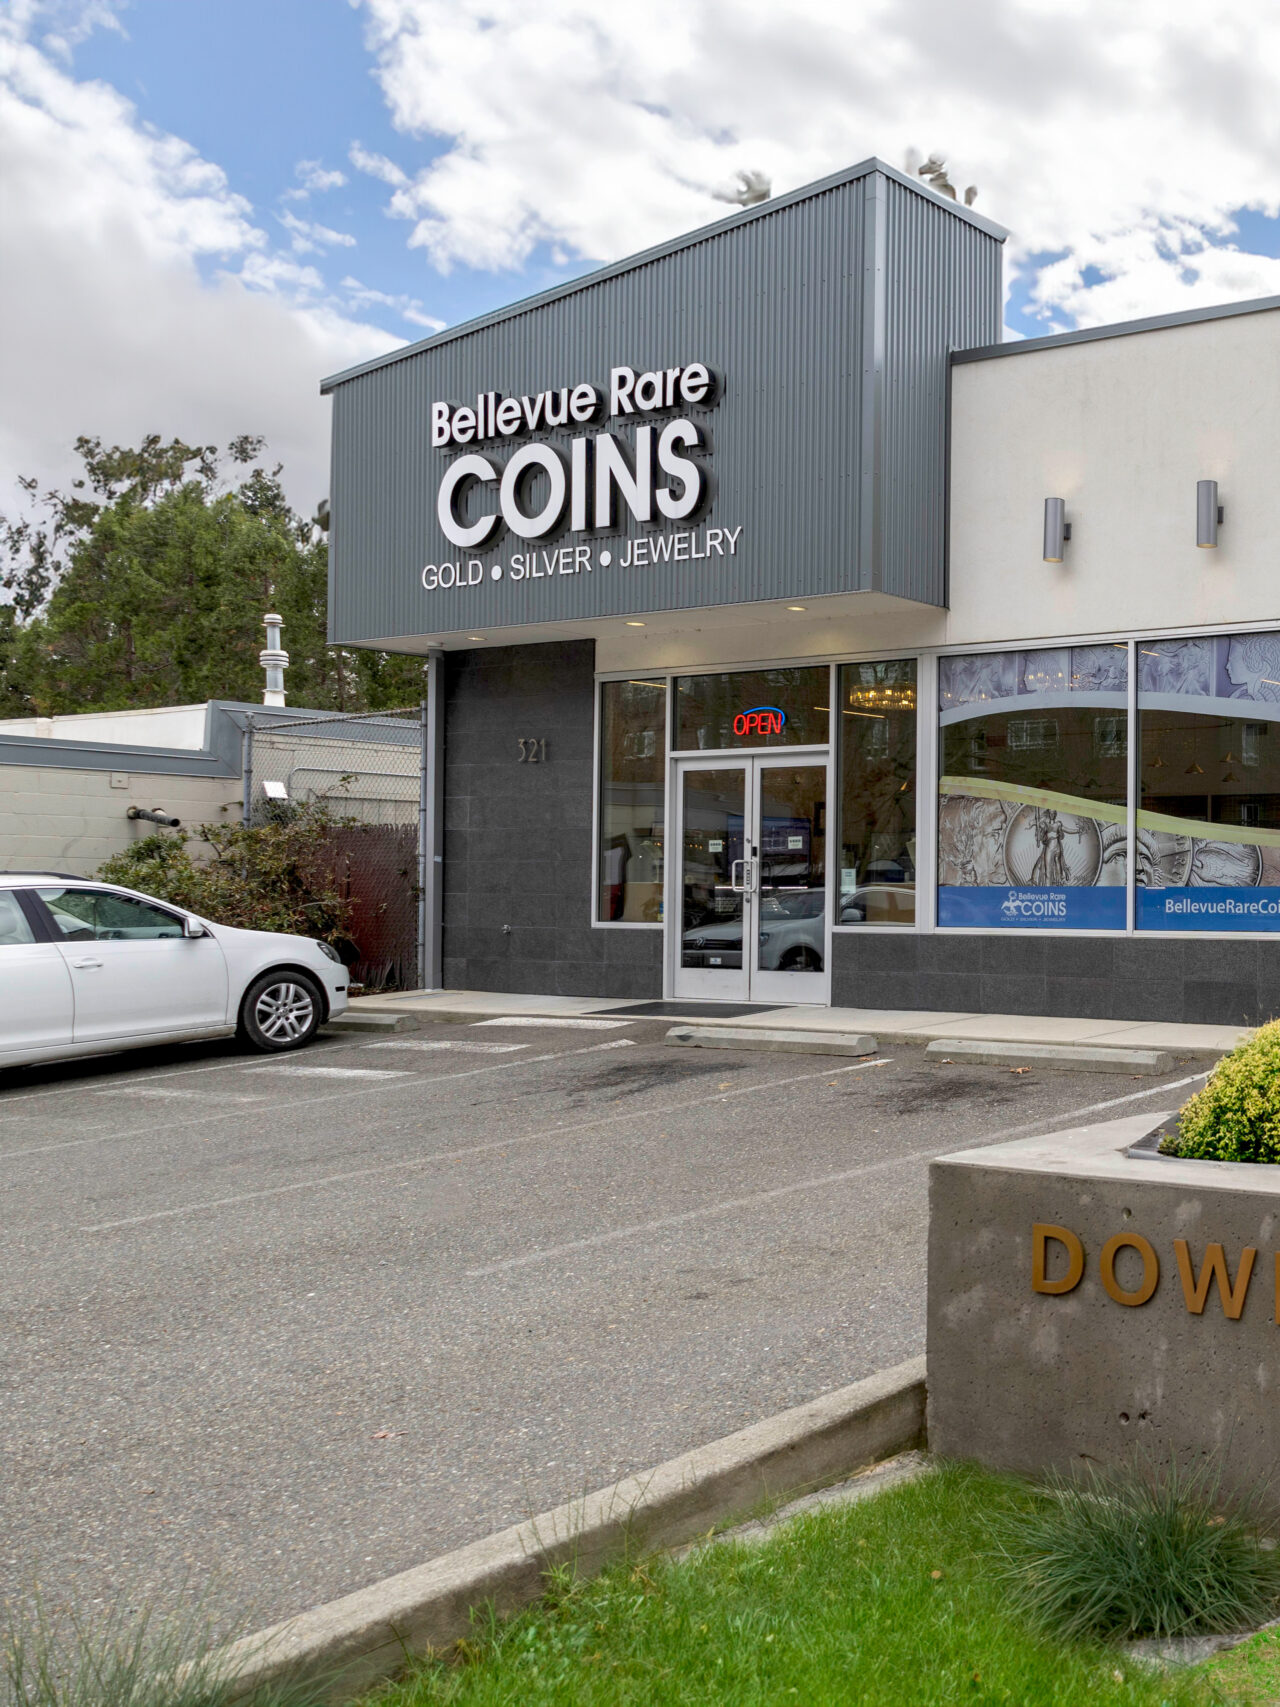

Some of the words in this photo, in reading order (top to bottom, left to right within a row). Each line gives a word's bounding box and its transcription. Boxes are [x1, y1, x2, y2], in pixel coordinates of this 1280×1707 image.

[432, 383, 599, 448] Bellevue
[610, 362, 713, 416] Rare
[437, 418, 702, 548] COINS
[421, 559, 484, 590] GOLD
[509, 545, 592, 581] SILVER
[619, 526, 742, 568] JEWELRY
[733, 712, 782, 736] OPEN
[517, 738, 546, 763] 321
[1018, 892, 1048, 901] Bellevue
[1049, 892, 1067, 901] Rare
[1021, 901, 1067, 916] COINS
